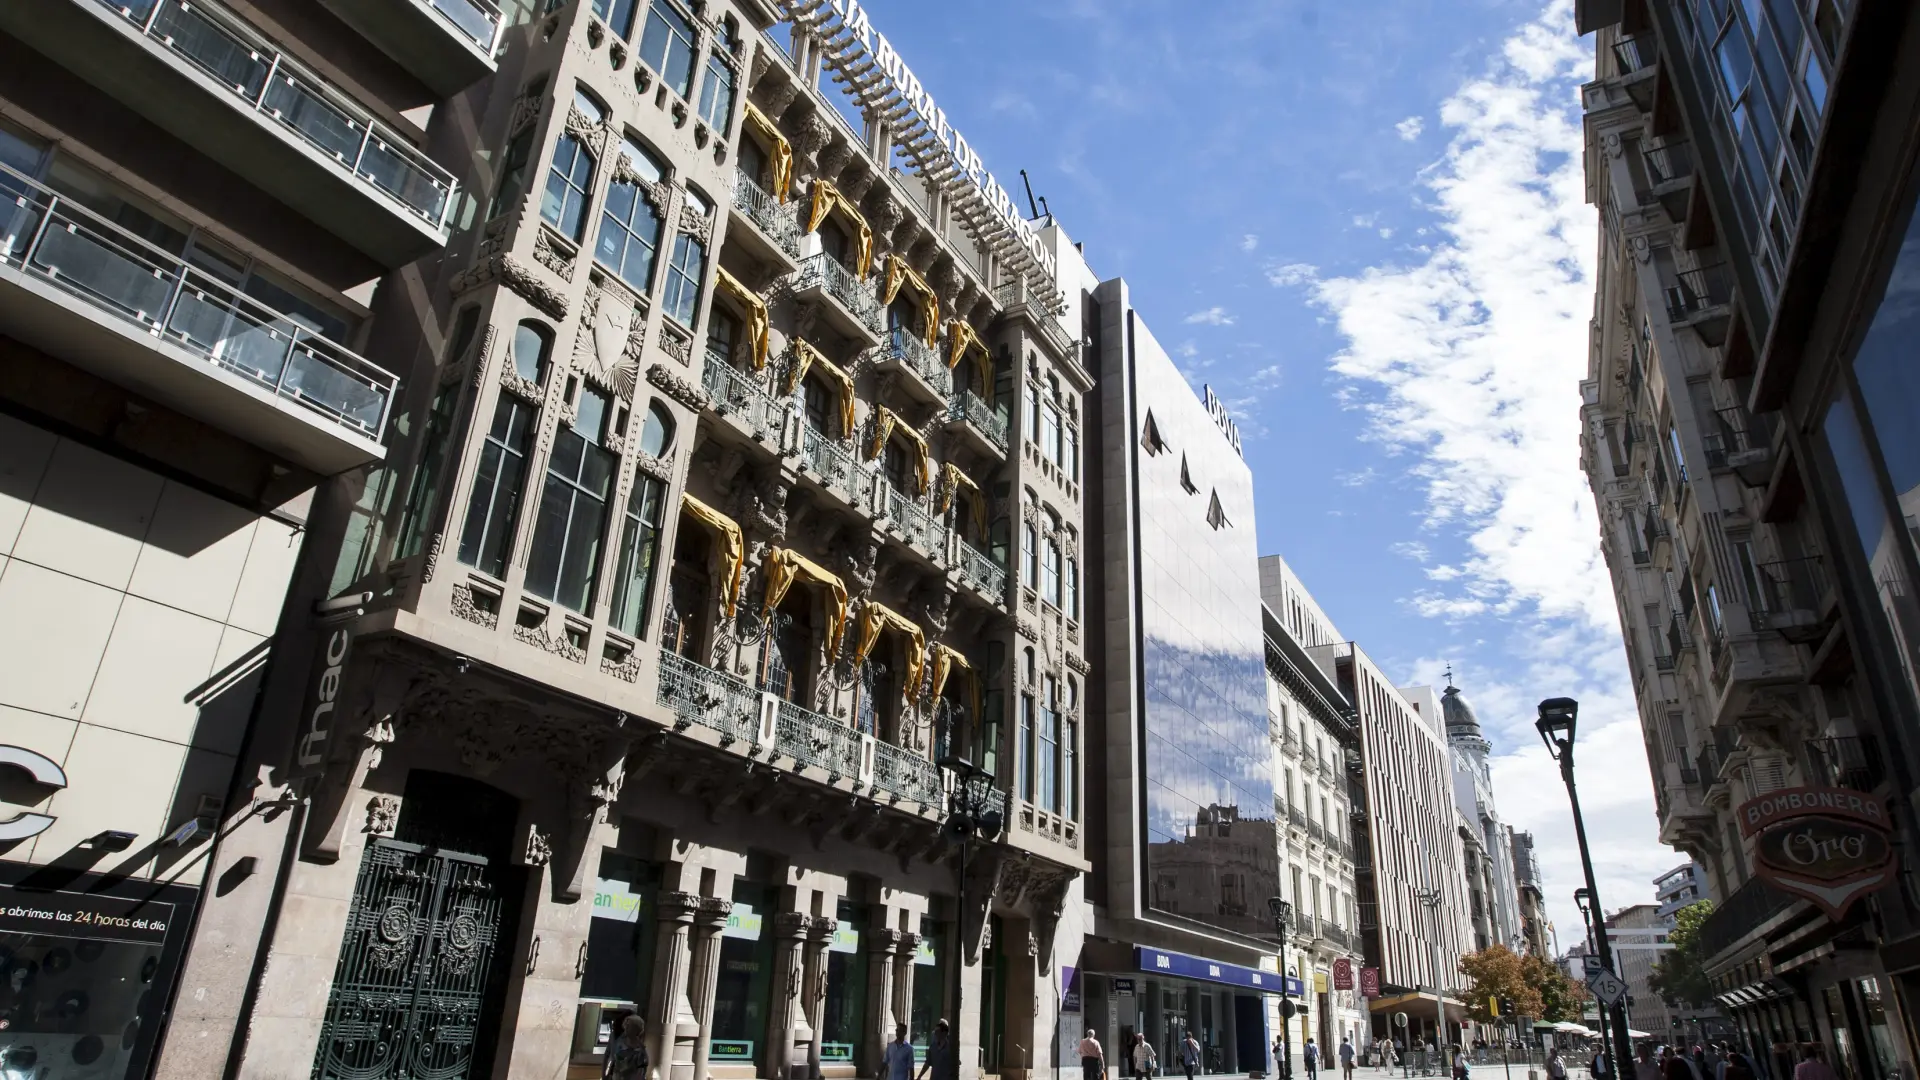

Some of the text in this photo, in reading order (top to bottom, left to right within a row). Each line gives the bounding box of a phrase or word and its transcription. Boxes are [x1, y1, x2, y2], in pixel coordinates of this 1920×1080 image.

[876, 31, 952, 148] RURAL
[952, 129, 987, 187] DE
[983, 172, 1056, 277] ARAGON
[1205, 384, 1244, 460] BBVA
[298, 629, 348, 767] fnac
[1747, 792, 1882, 824] BOMBONERA
[1782, 828, 1866, 866] Oro
[7, 906, 54, 920] abrimos
[56, 910, 72, 922] las
[74, 911, 91, 923] 24
[94, 914, 130, 928] horas
[132, 919, 148, 929] del
[149, 920, 166, 931] día
[1157, 954, 1170, 969] BBVA
[1599, 980, 1617, 994] 15
[718, 1045, 742, 1054] Bantierra
